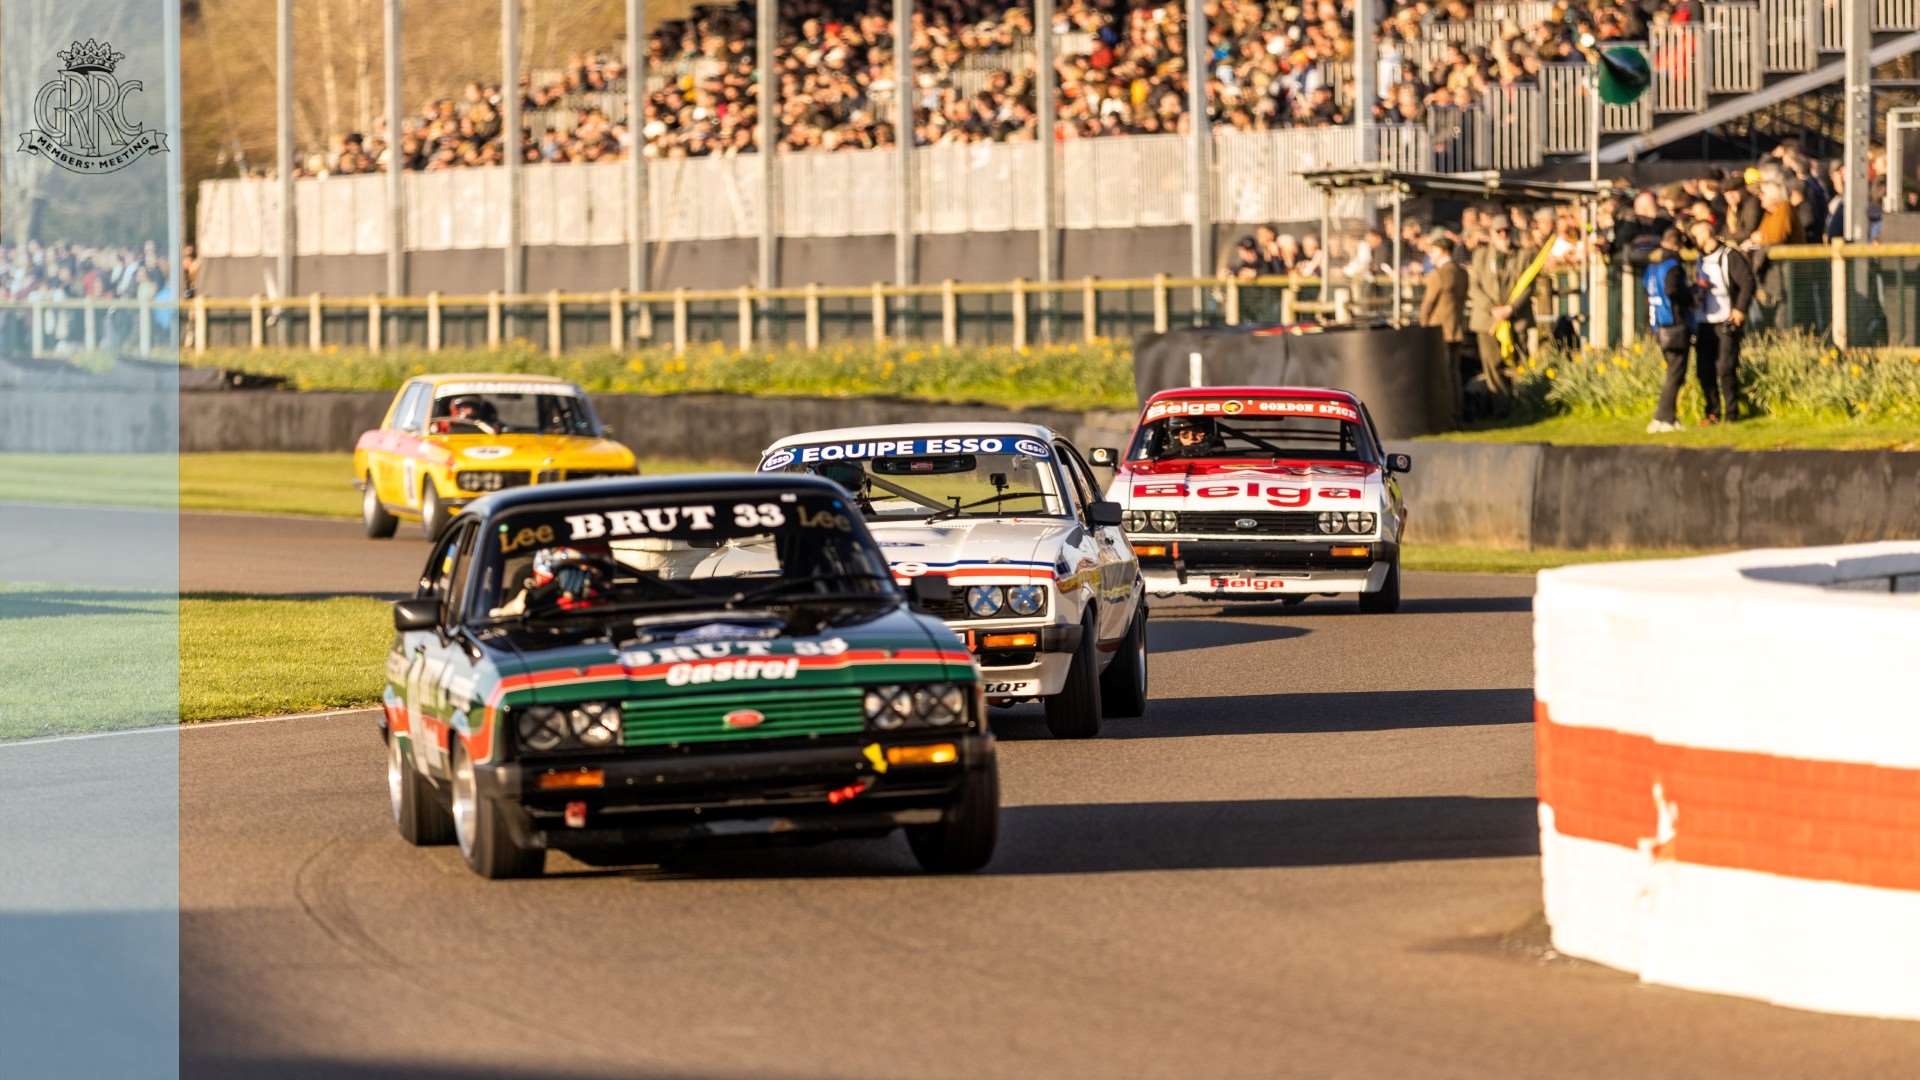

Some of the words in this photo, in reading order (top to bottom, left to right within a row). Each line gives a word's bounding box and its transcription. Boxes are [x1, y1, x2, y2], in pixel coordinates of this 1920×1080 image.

[1147, 401, 1220, 419] Belga
[1259, 402, 1314, 413] GORDON
[1319, 404, 1357, 419] SPICE
[801, 440, 914, 462] EQUIPE
[926, 438, 1003, 453] ESSO
[1133, 482, 1361, 507] Belga
[564, 506, 716, 541] BRUT
[733, 503, 785, 528] 33
[797, 505, 852, 532] Lee
[499, 524, 554, 553] Lee
[1210, 577, 1285, 590] Belga
[617, 640, 772, 667] BRUT
[665, 657, 800, 687] Castrol
[983, 681, 1028, 693] LOP
